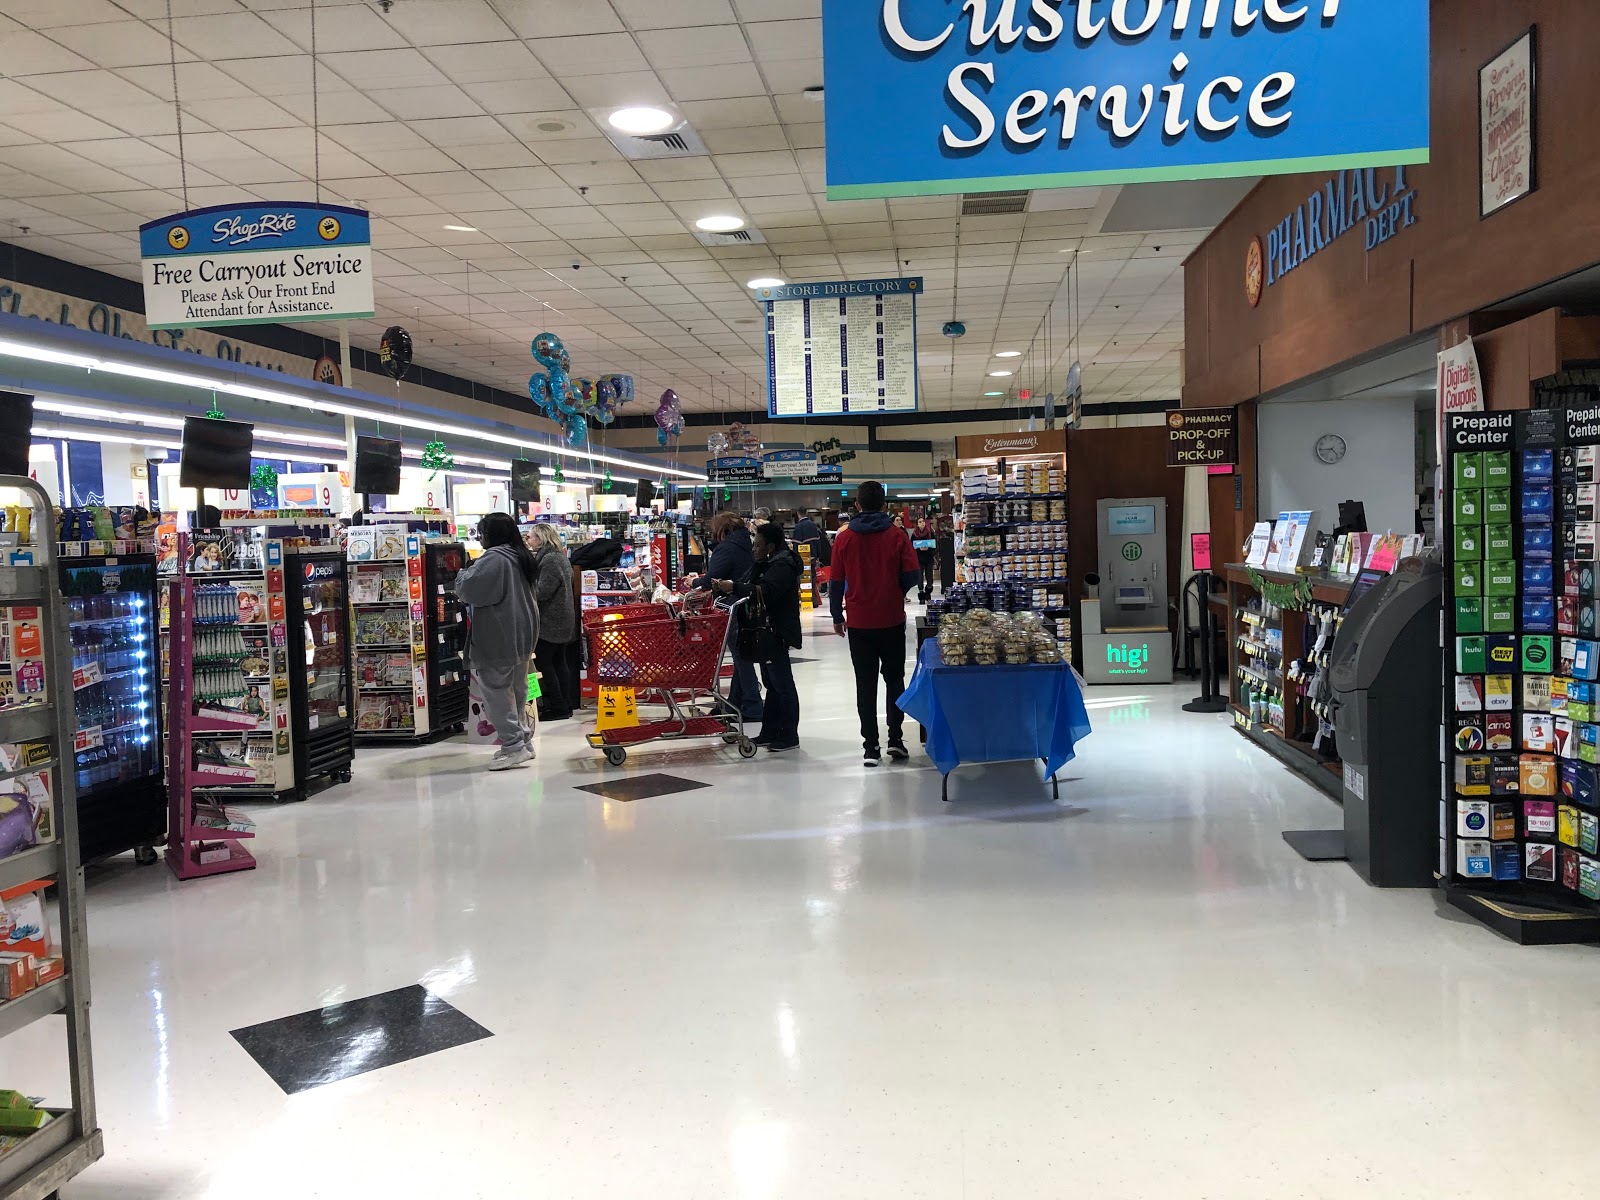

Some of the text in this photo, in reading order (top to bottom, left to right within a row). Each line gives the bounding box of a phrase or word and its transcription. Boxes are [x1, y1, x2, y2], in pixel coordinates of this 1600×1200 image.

[943, 52, 1296, 149] Service
[212, 212, 297, 245] ShopRite
[1364, 190, 1417, 251] DEPT.
[152, 253, 363, 286] Free Carryout Service
[181, 280, 336, 304] Please Ask Our Front End
[777, 281, 903, 298] STORE DIRECTORY
[185, 299, 334, 319] Attendant for Assistance.
[1447, 363, 1469, 391] Digital
[1446, 387, 1477, 411] Coupons
[1185, 415, 1232, 424] PHARMACY
[1566, 405, 1600, 423] Prepai
[1452, 414, 1512, 431] Prepaid
[1170, 429, 1231, 441] DROP-OFF
[1456, 431, 1509, 445] Center
[813, 437, 841, 453] Chef's
[984, 436, 1038, 452] Entenmann's
[1195, 439, 1206, 449] &
[821, 450, 856, 465] Express
[1177, 450, 1224, 461] PICK-UP
[323, 488, 331, 505] 9
[427, 492, 434, 507] 8
[492, 495, 498, 509] 7
[545, 498, 551, 510] 6
[577, 500, 582, 511] 5
[194, 532, 220, 540] Friendship
[316, 566, 334, 578] pepsi
[102, 574, 121, 587] Spring
[1107, 643, 1148, 667] higi
[1491, 698, 1508, 706] ebay
